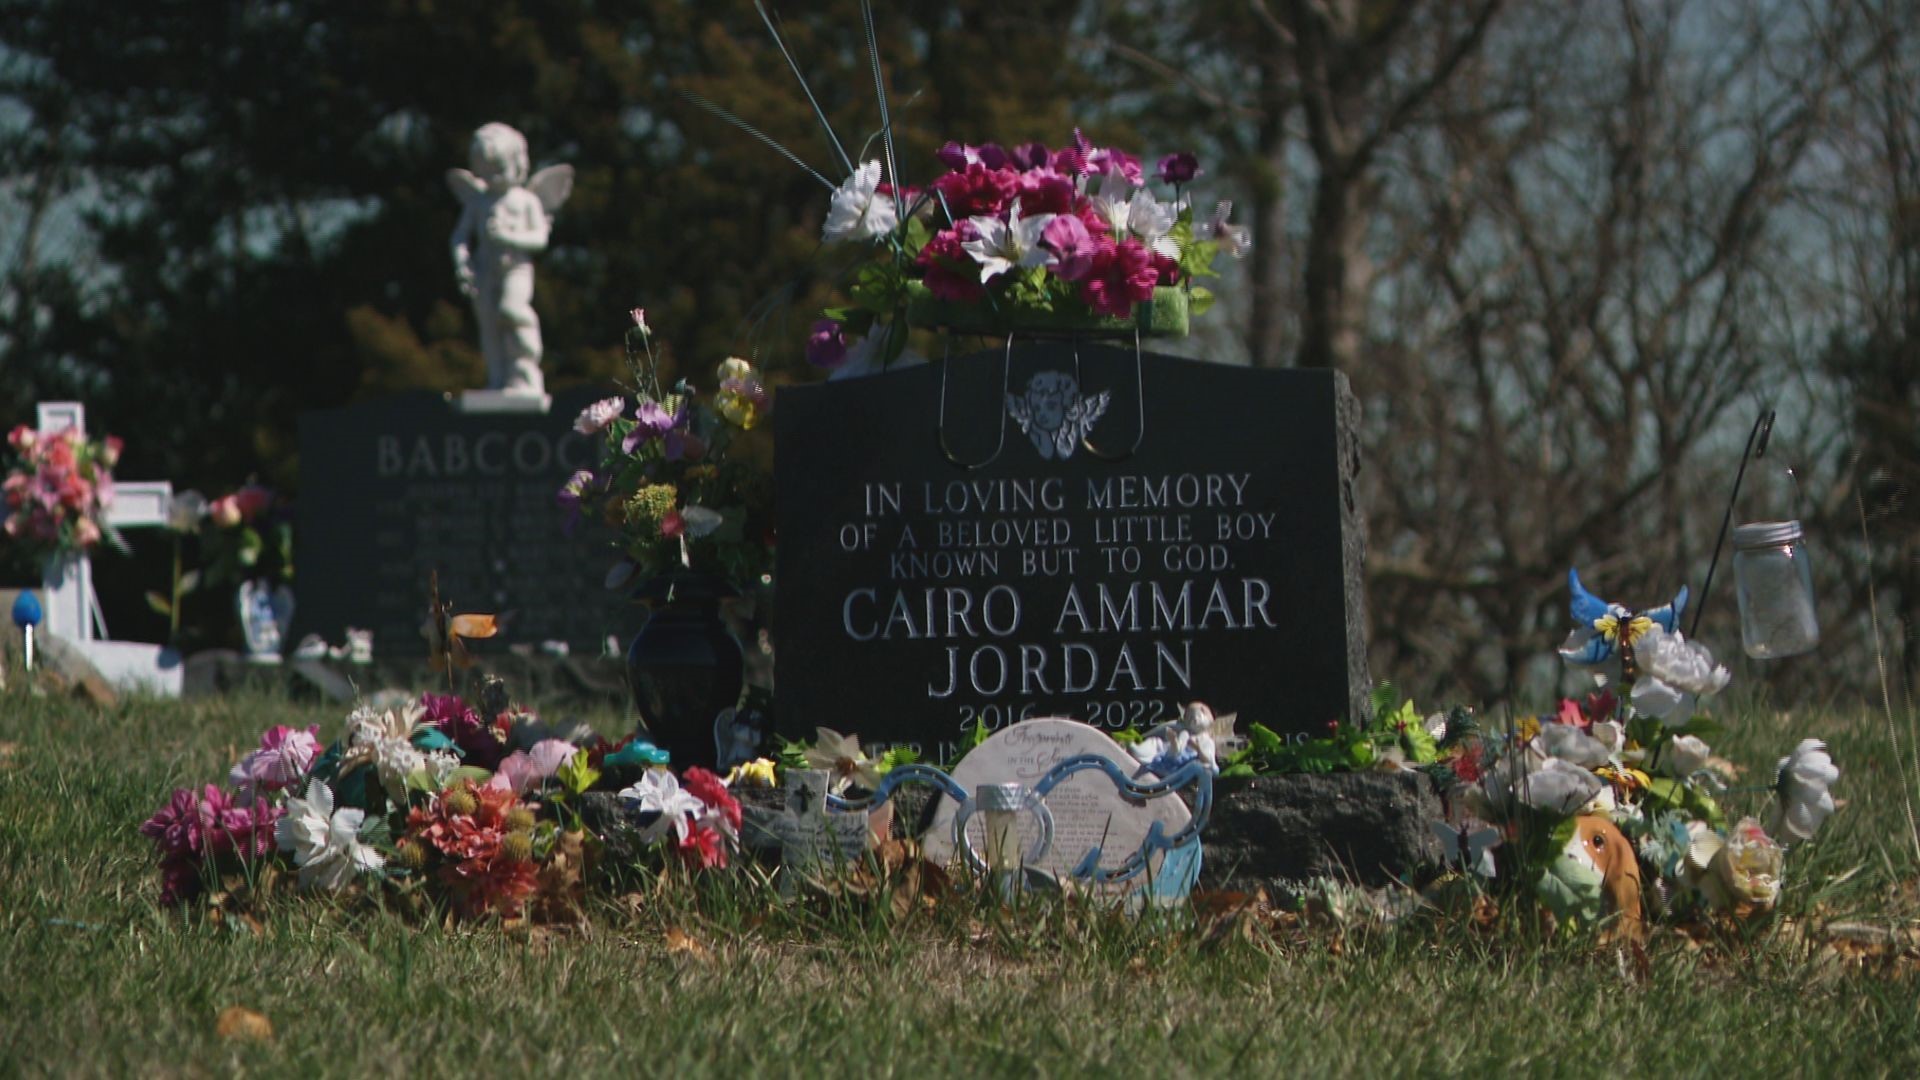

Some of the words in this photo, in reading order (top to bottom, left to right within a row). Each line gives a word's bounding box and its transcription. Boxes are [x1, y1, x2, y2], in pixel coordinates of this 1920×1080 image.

[864, 482, 902, 516] IN
[924, 478, 1065, 515] LOVING
[1086, 473, 1251, 511] MEMORY
[839, 523, 877, 551] OF
[898, 524, 918, 549] A
[938, 518, 1072, 549] BELOVED
[1095, 514, 1193, 544] LITTLE
[1217, 512, 1277, 541] BOY
[890, 550, 999, 580] KNOWN
[1022, 548, 1080, 577] BUT
[1101, 546, 1141, 574] TO
[1163, 543, 1236, 573] GOD.
[842, 583, 1022, 641] CAIRO
[1053, 578, 1278, 634] AMMAR
[927, 639, 1193, 699] JORDAN
[959, 702, 1037, 731] 2016
[1086, 699, 1166, 728] 2022
